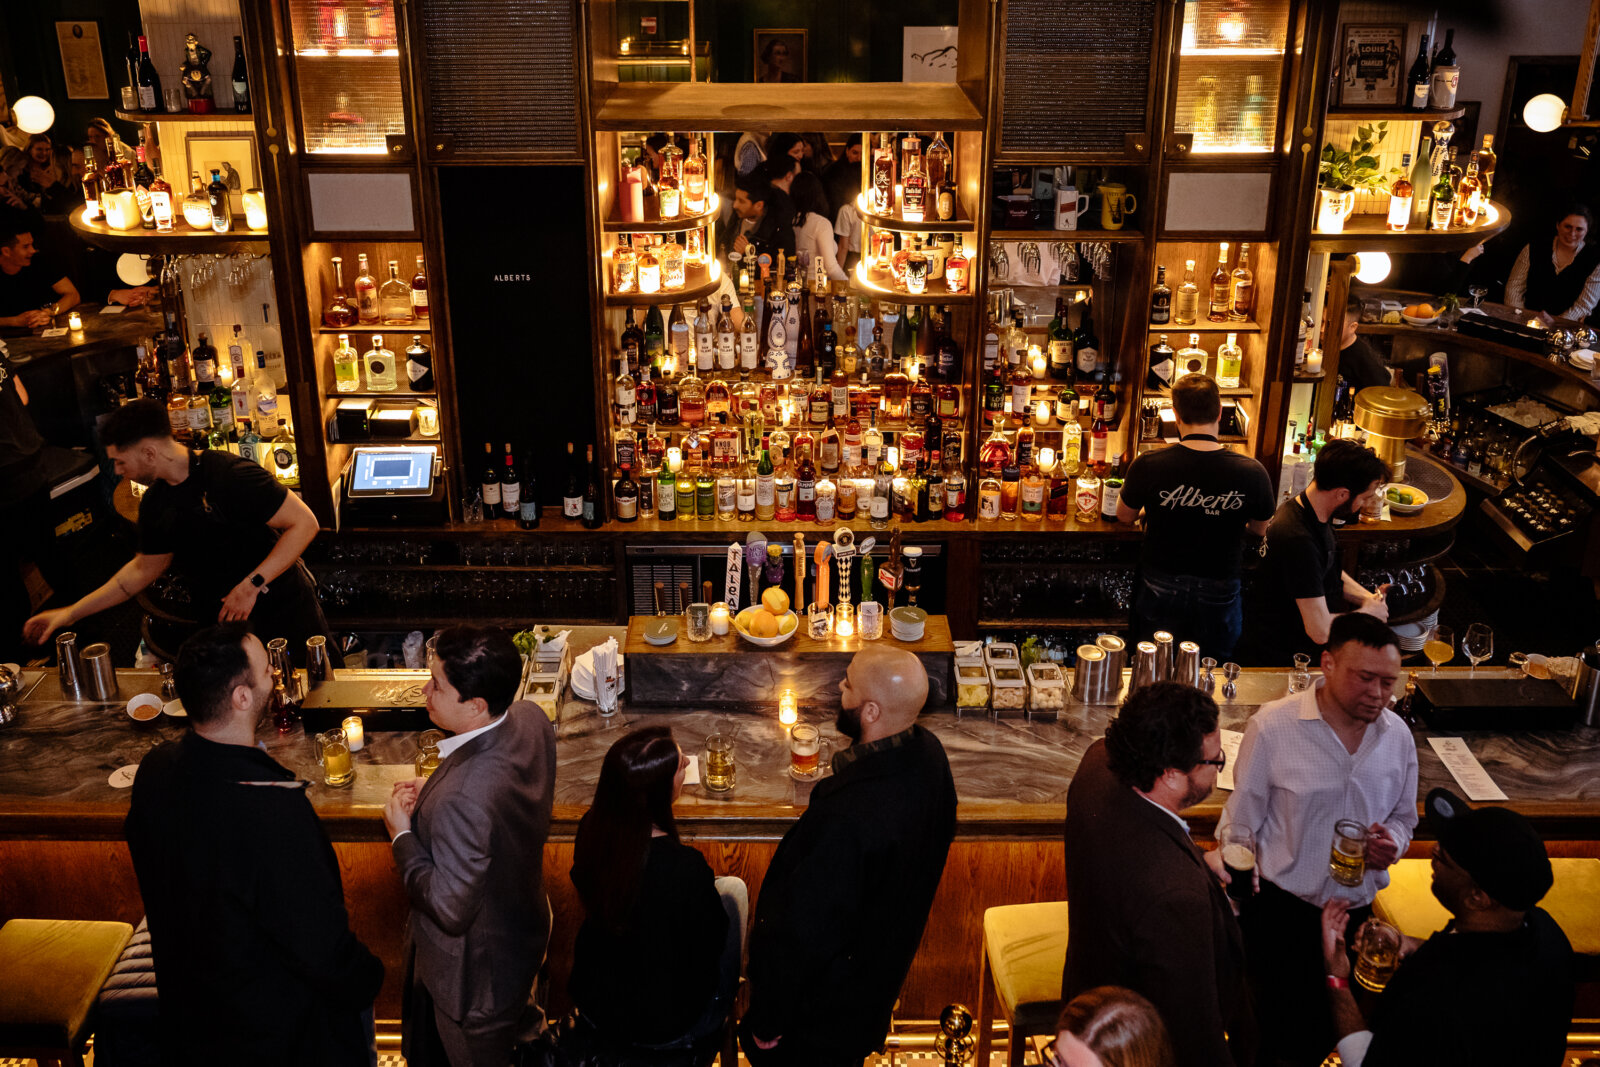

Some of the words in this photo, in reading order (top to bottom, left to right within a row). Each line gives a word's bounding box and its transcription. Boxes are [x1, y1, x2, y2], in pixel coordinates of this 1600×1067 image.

[1361, 45, 1385, 53] LOUIS
[494, 274, 531, 282] ALBERTS
[715, 440, 731, 448] KNOB
[1159, 484, 1246, 510] Albert's
[1205, 508, 1220, 516] BAR
